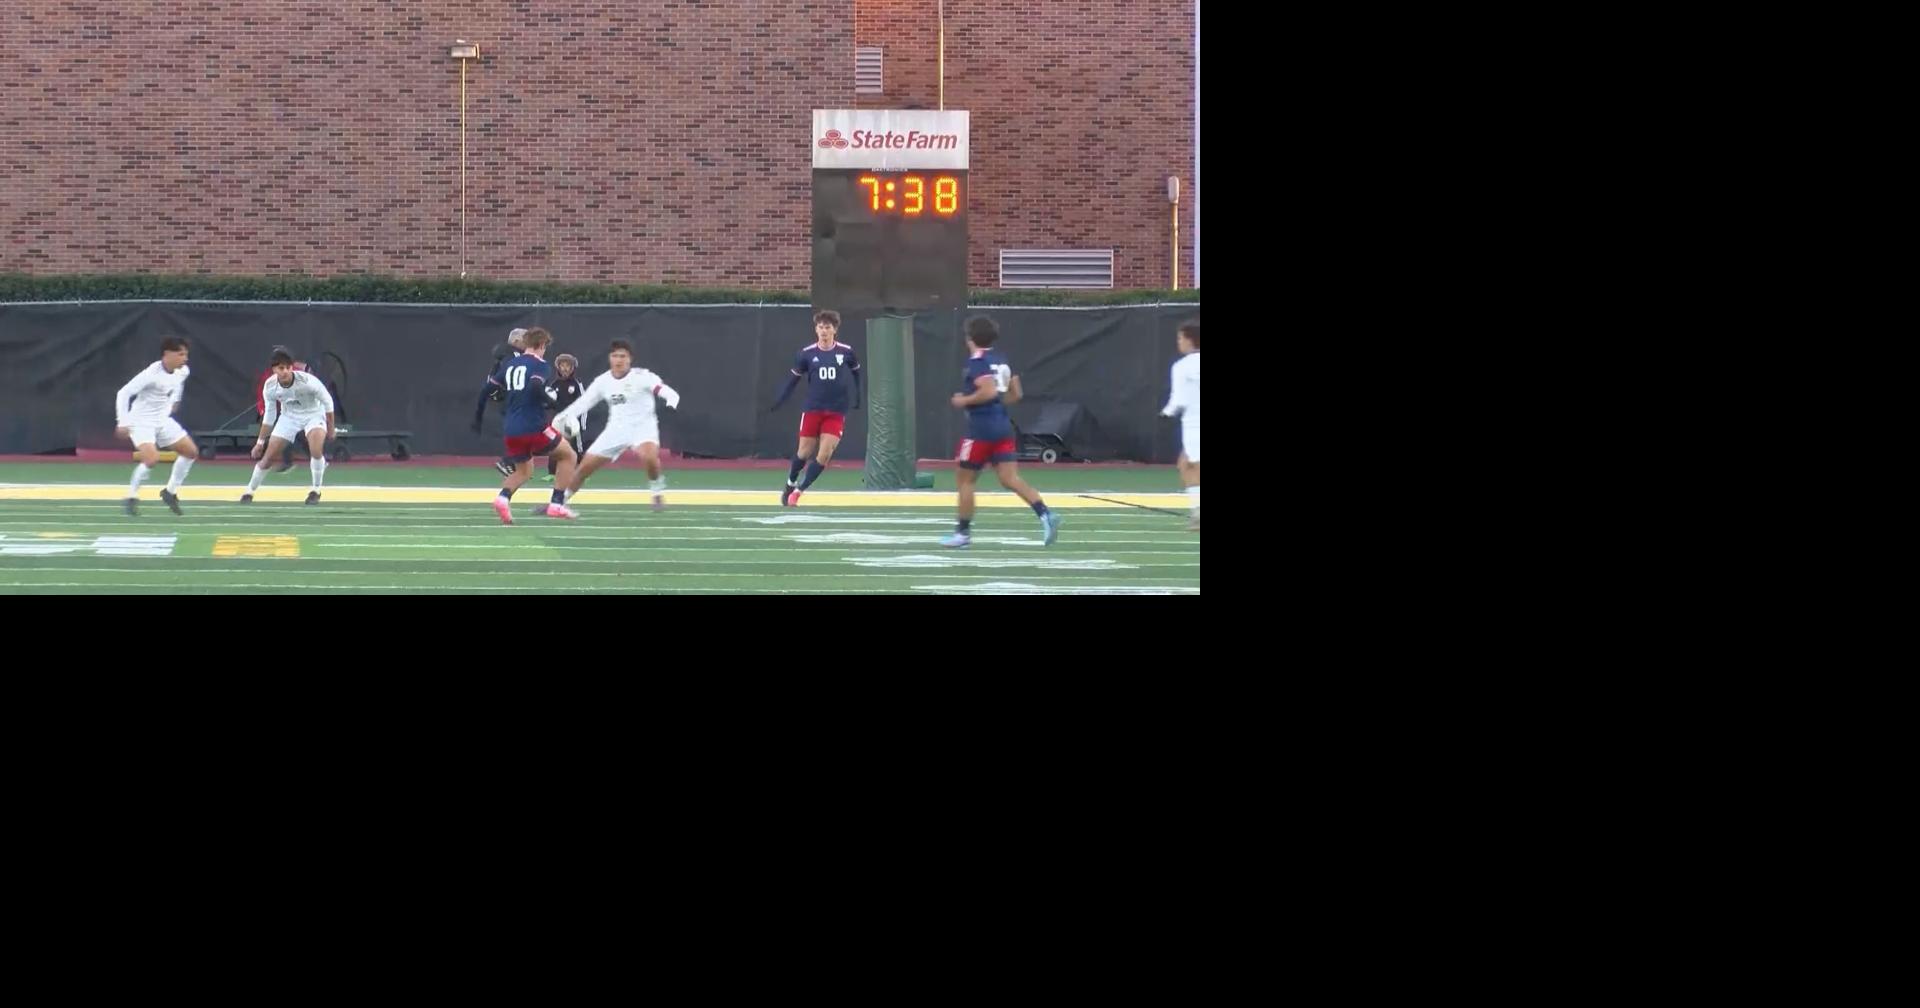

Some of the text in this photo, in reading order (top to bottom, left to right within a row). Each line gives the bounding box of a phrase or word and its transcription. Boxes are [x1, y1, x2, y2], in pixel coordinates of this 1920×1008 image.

[859, 176, 958, 213] 7:38
[505, 365, 527, 391] 10
[819, 366, 836, 380] 00
